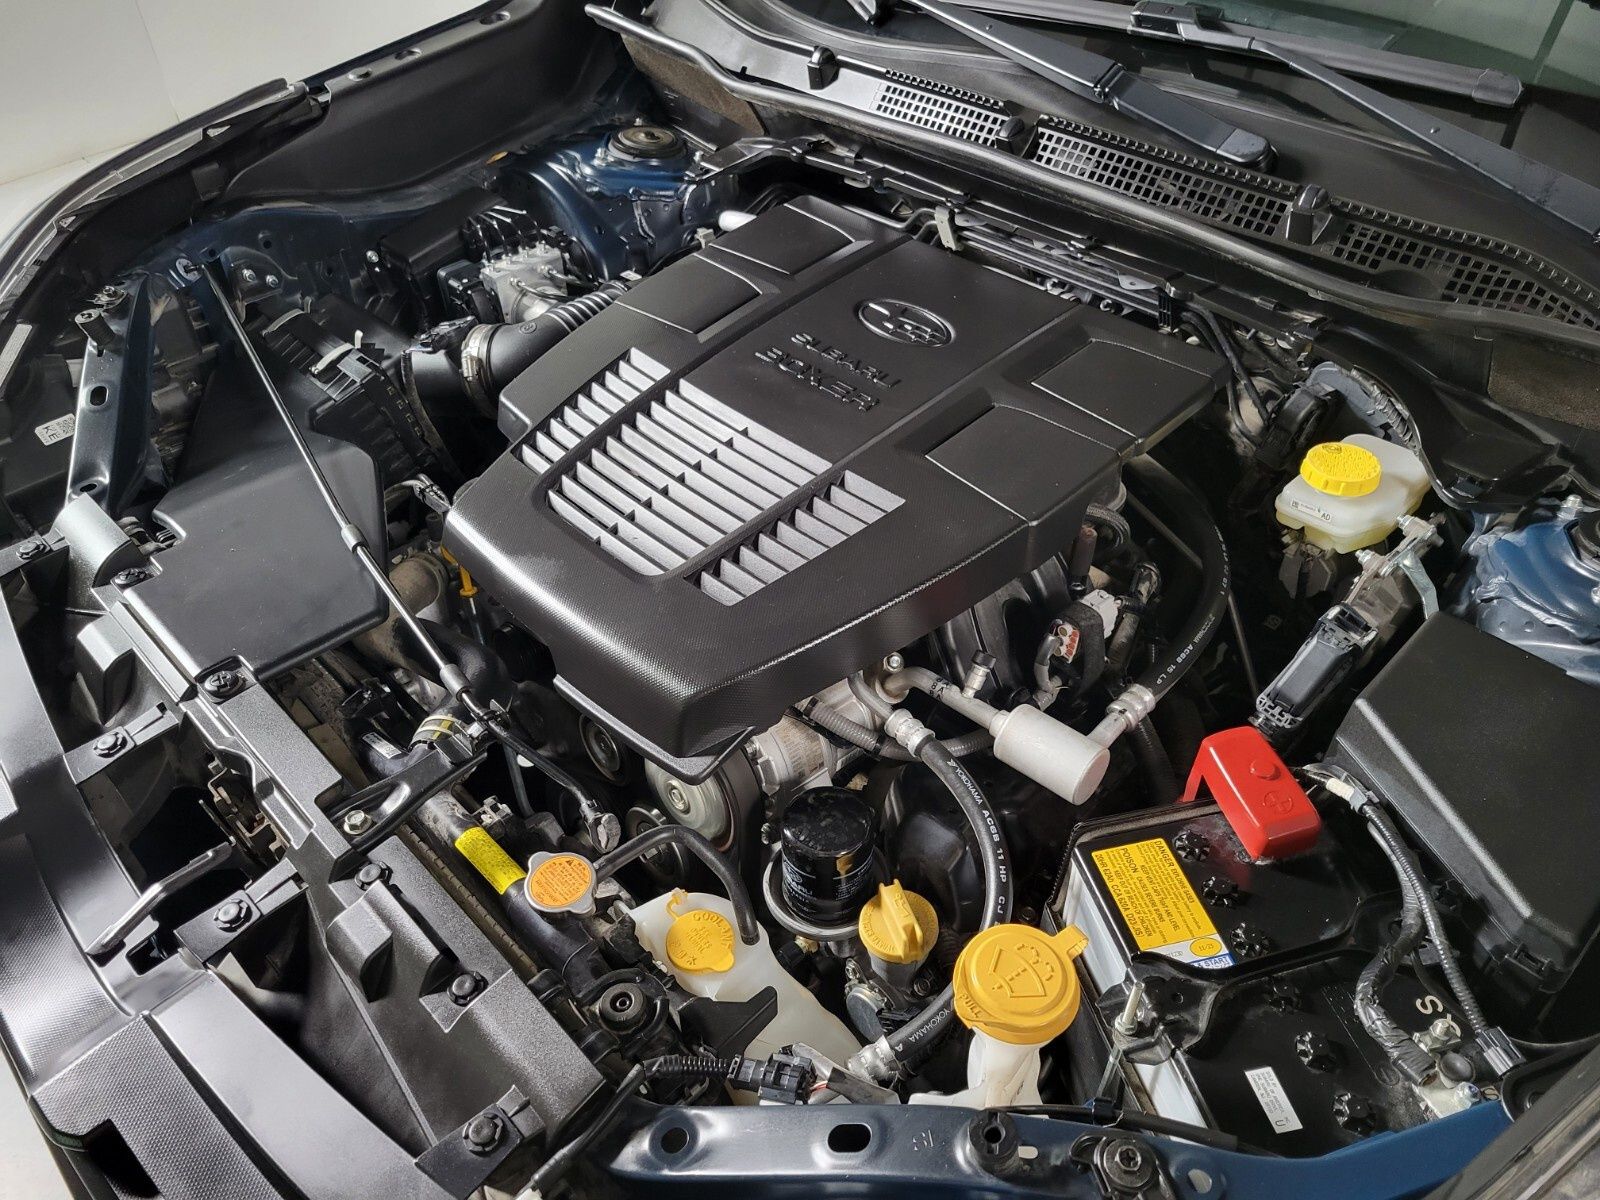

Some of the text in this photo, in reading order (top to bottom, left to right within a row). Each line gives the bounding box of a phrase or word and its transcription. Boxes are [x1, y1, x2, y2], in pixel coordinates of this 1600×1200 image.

[790, 333, 902, 388] SUBARU
[755, 347, 881, 411] BOXER
[954, 766, 983, 806] YOKOHAMA
[996, 848, 1006, 861] 11
[1119, 848, 1139, 872] POISON
[1153, 840, 1174, 867] DANGER
[998, 865, 1008, 883] HP
[996, 895, 1007, 915] CJ
[692, 911, 733, 949] COOLANT
[1203, 956, 1229, 967] START
[959, 993, 983, 1019] PULL
[908, 1007, 951, 1043] YOKOHAMA
